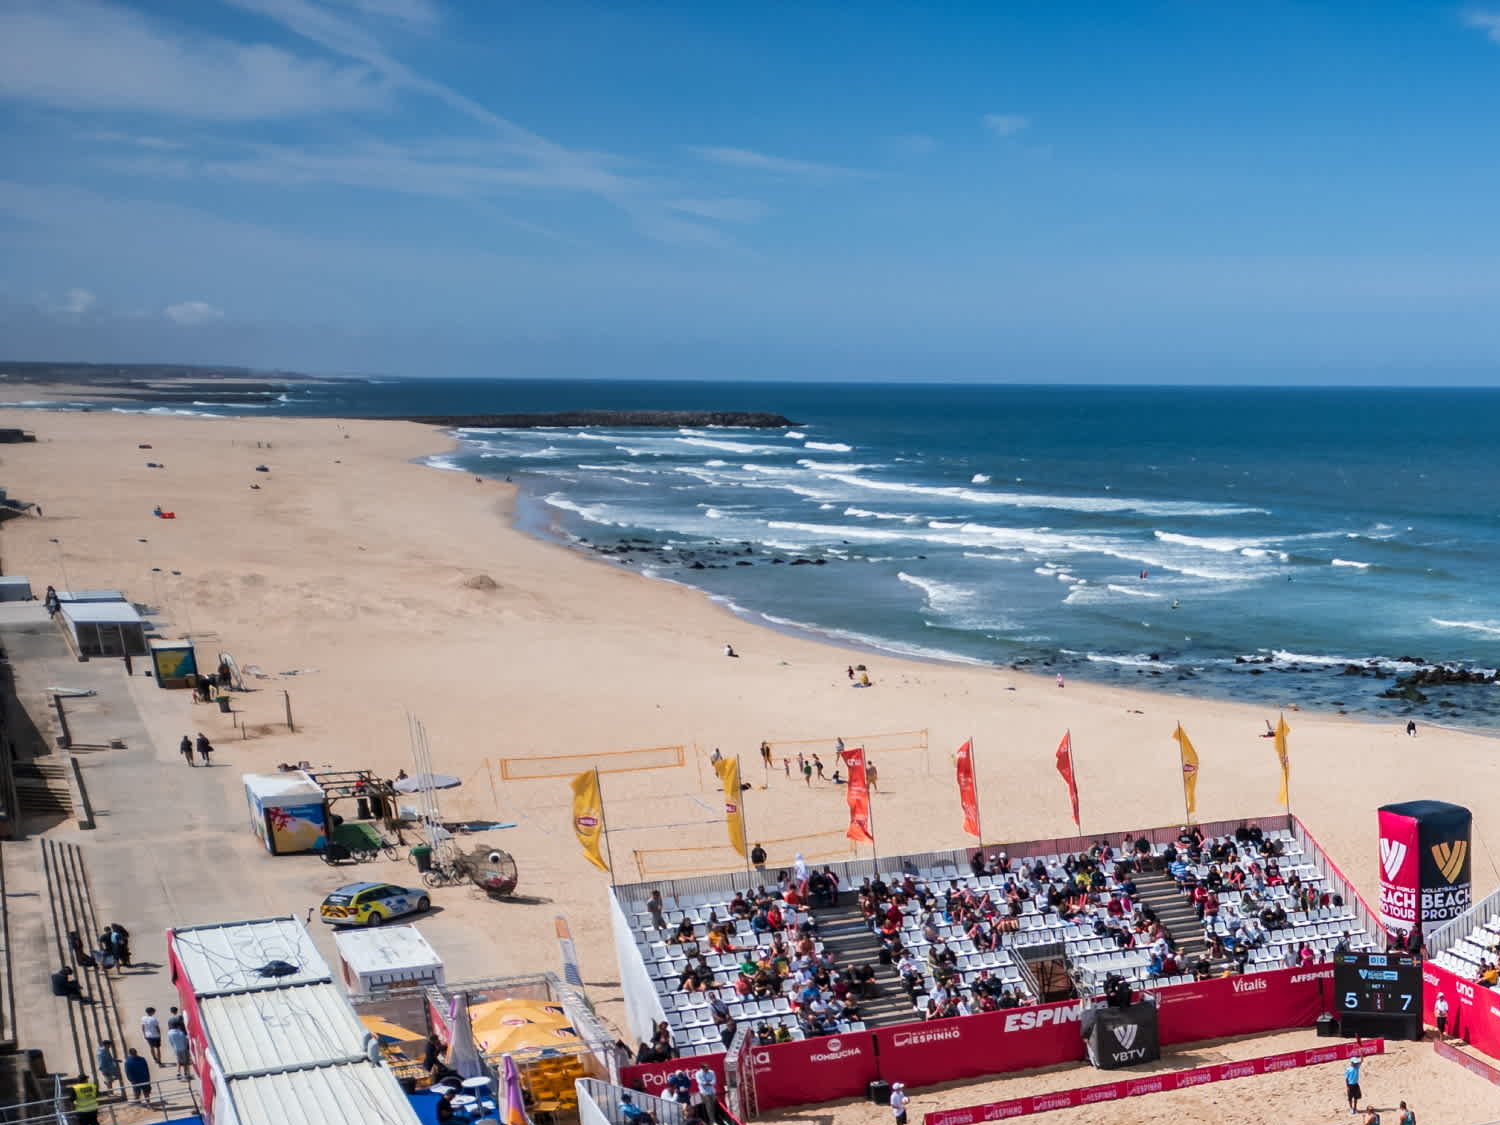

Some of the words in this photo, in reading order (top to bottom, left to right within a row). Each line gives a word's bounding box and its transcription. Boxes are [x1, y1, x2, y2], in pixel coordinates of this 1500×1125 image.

[1380, 885, 1416, 909] EACH
[1421, 888, 1472, 909] BEACH
[1389, 905, 1416, 920] TOUR
[1421, 909, 1448, 920] PRO
[1290, 969, 1335, 984] AFFSPORT
[1232, 977, 1267, 993] Vitalis
[1344, 991, 1358, 1009] 5
[1400, 994, 1412, 1011] 7
[1003, 1000, 1108, 1033] ESPIN
[912, 1030, 961, 1045] ESPINHO
[1112, 1047, 1146, 1063] VBTV
